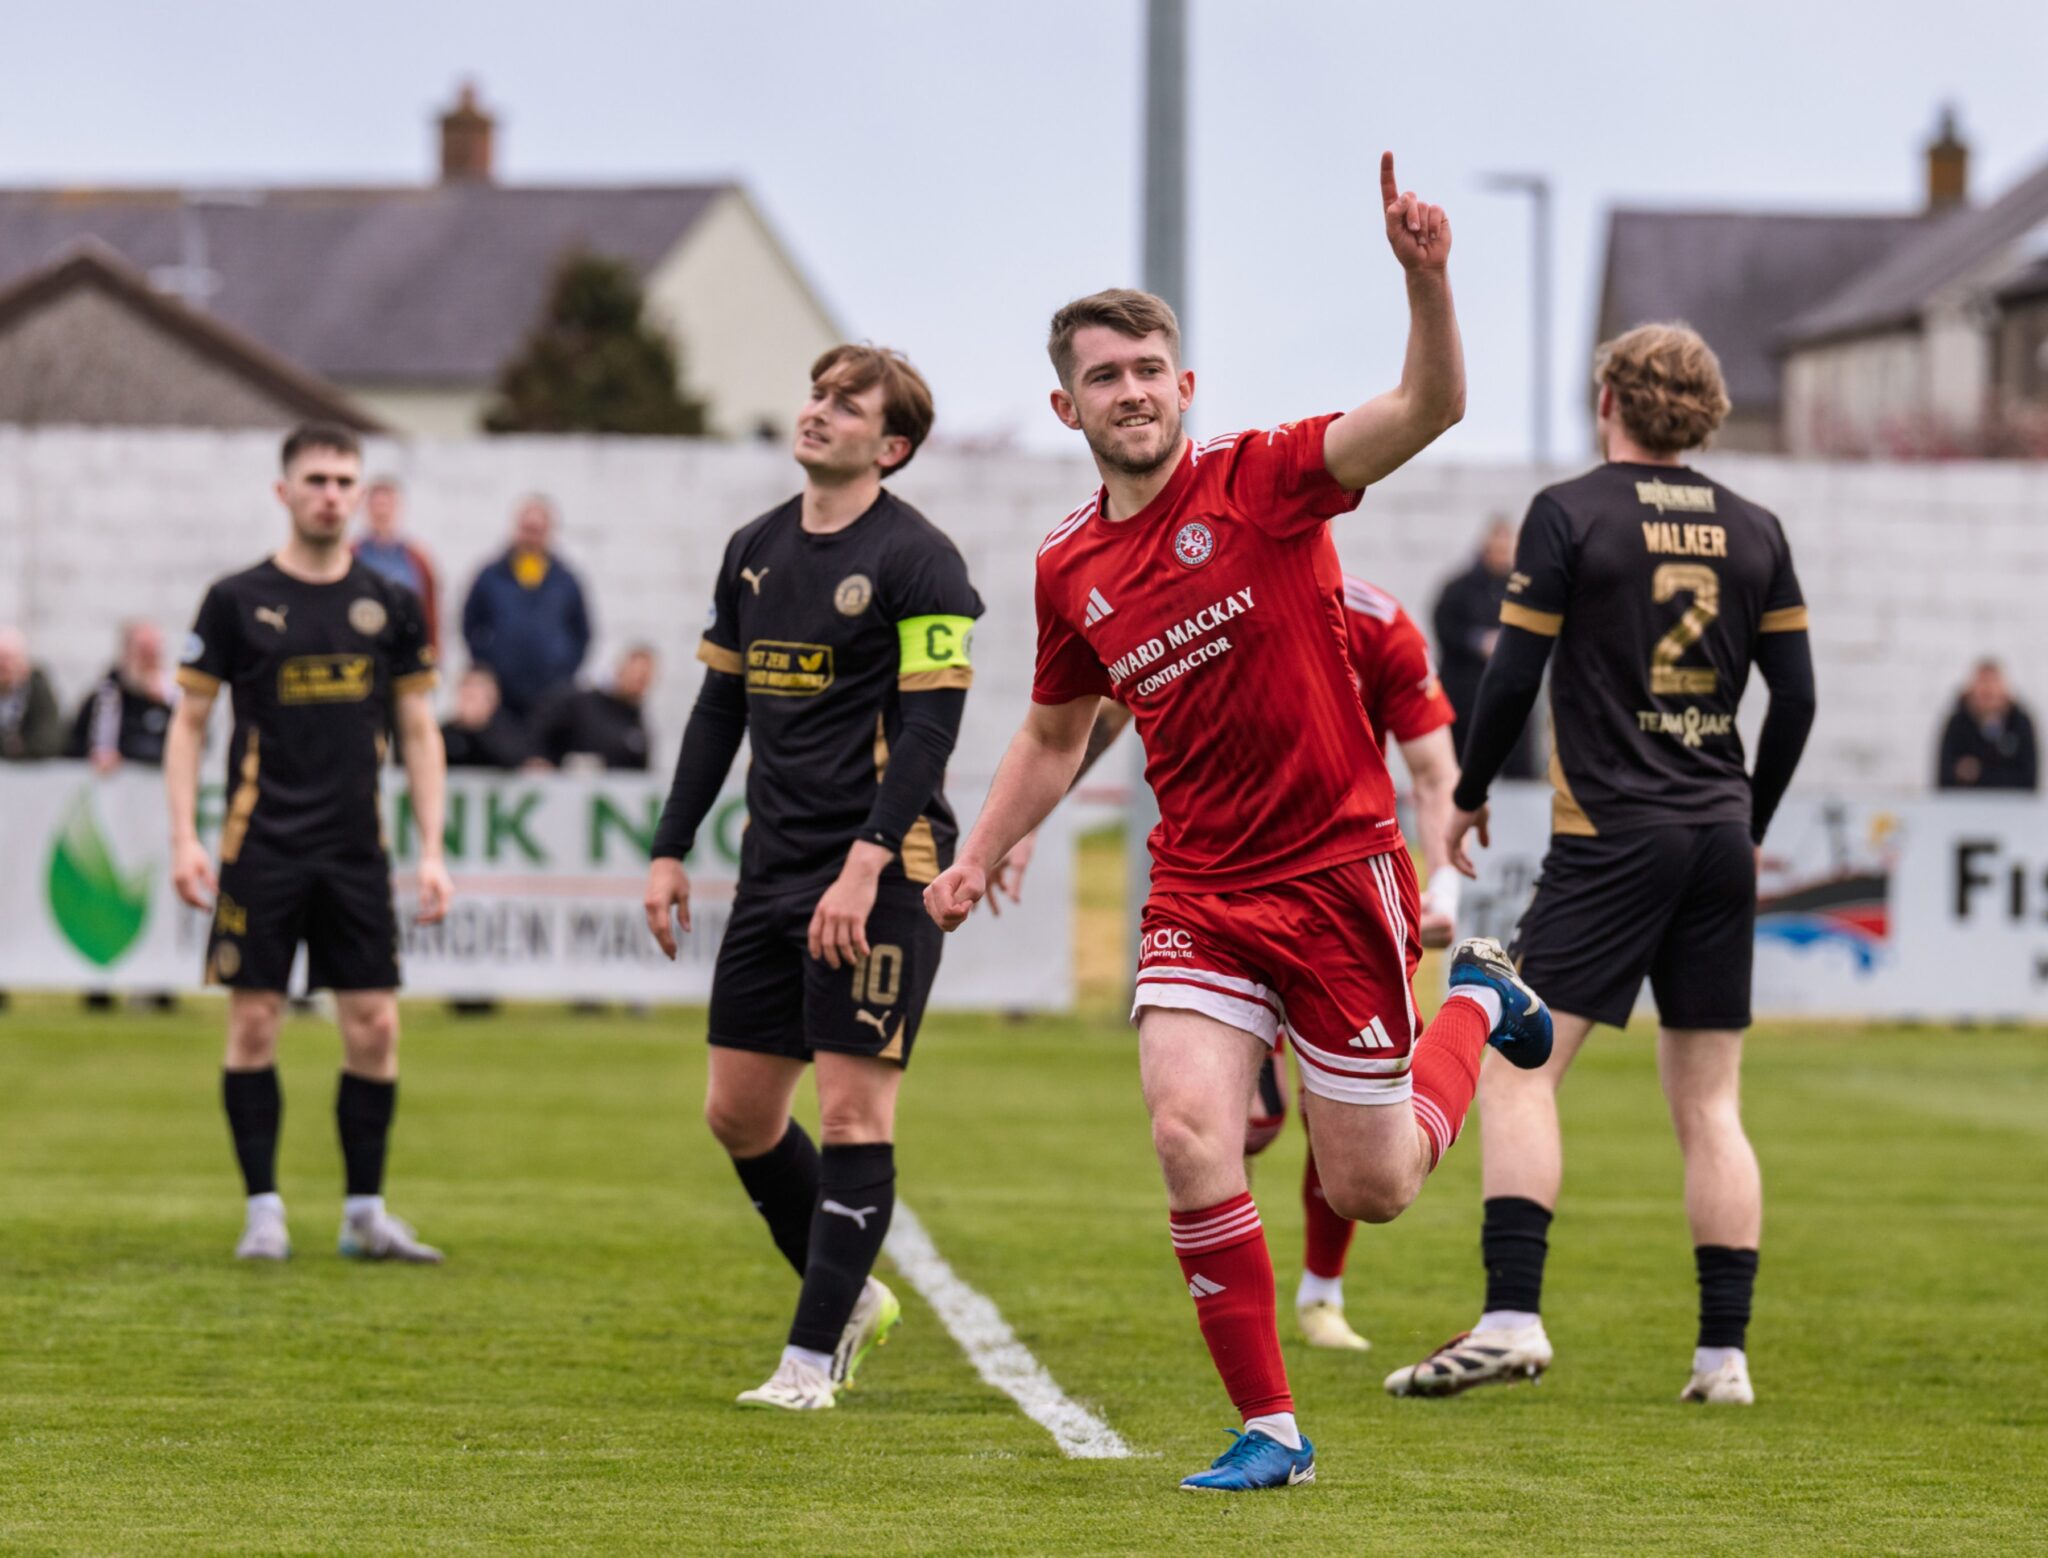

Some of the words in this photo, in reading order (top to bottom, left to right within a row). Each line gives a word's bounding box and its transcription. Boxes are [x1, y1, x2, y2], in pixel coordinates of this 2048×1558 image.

[1641, 520, 1728, 558] WALKER
[926, 623, 954, 661] C
[1107, 637, 1166, 685] DWARD
[1165, 586, 1256, 650] MACKAY
[1651, 562, 1719, 695] 2
[1136, 636, 1233, 696] CONTRACTOR
[1636, 711, 1684, 734] TEAM
[851, 943, 903, 1005] 10
